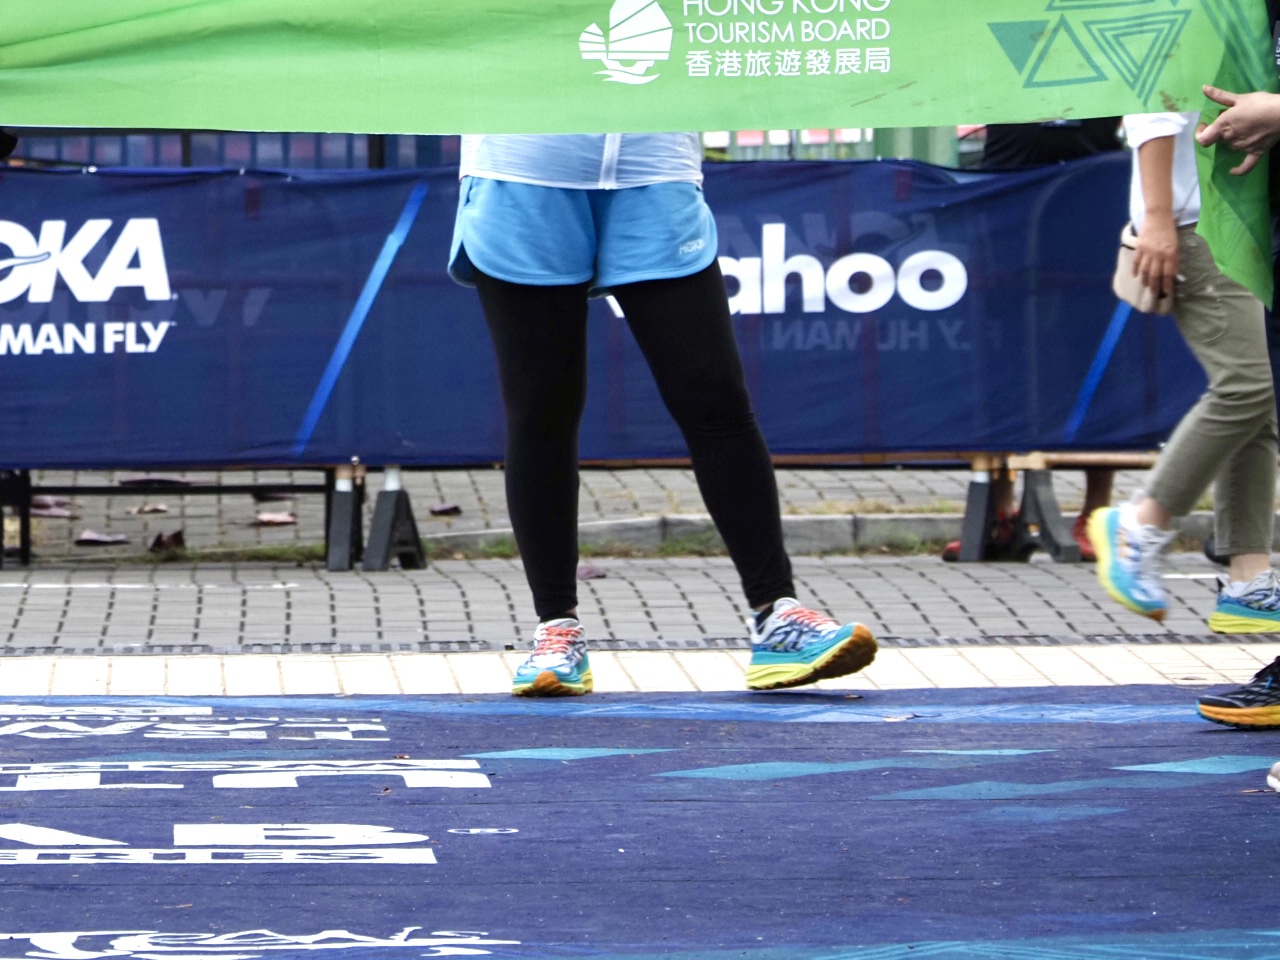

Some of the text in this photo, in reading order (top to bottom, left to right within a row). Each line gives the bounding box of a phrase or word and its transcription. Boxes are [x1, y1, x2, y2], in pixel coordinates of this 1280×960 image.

[684, 18, 891, 44] TOURISM BOARD
[684, 46, 891, 78] 香港旅遊發展局
[606, 223, 967, 318] ahoo
[103, 321, 169, 353] FLY
